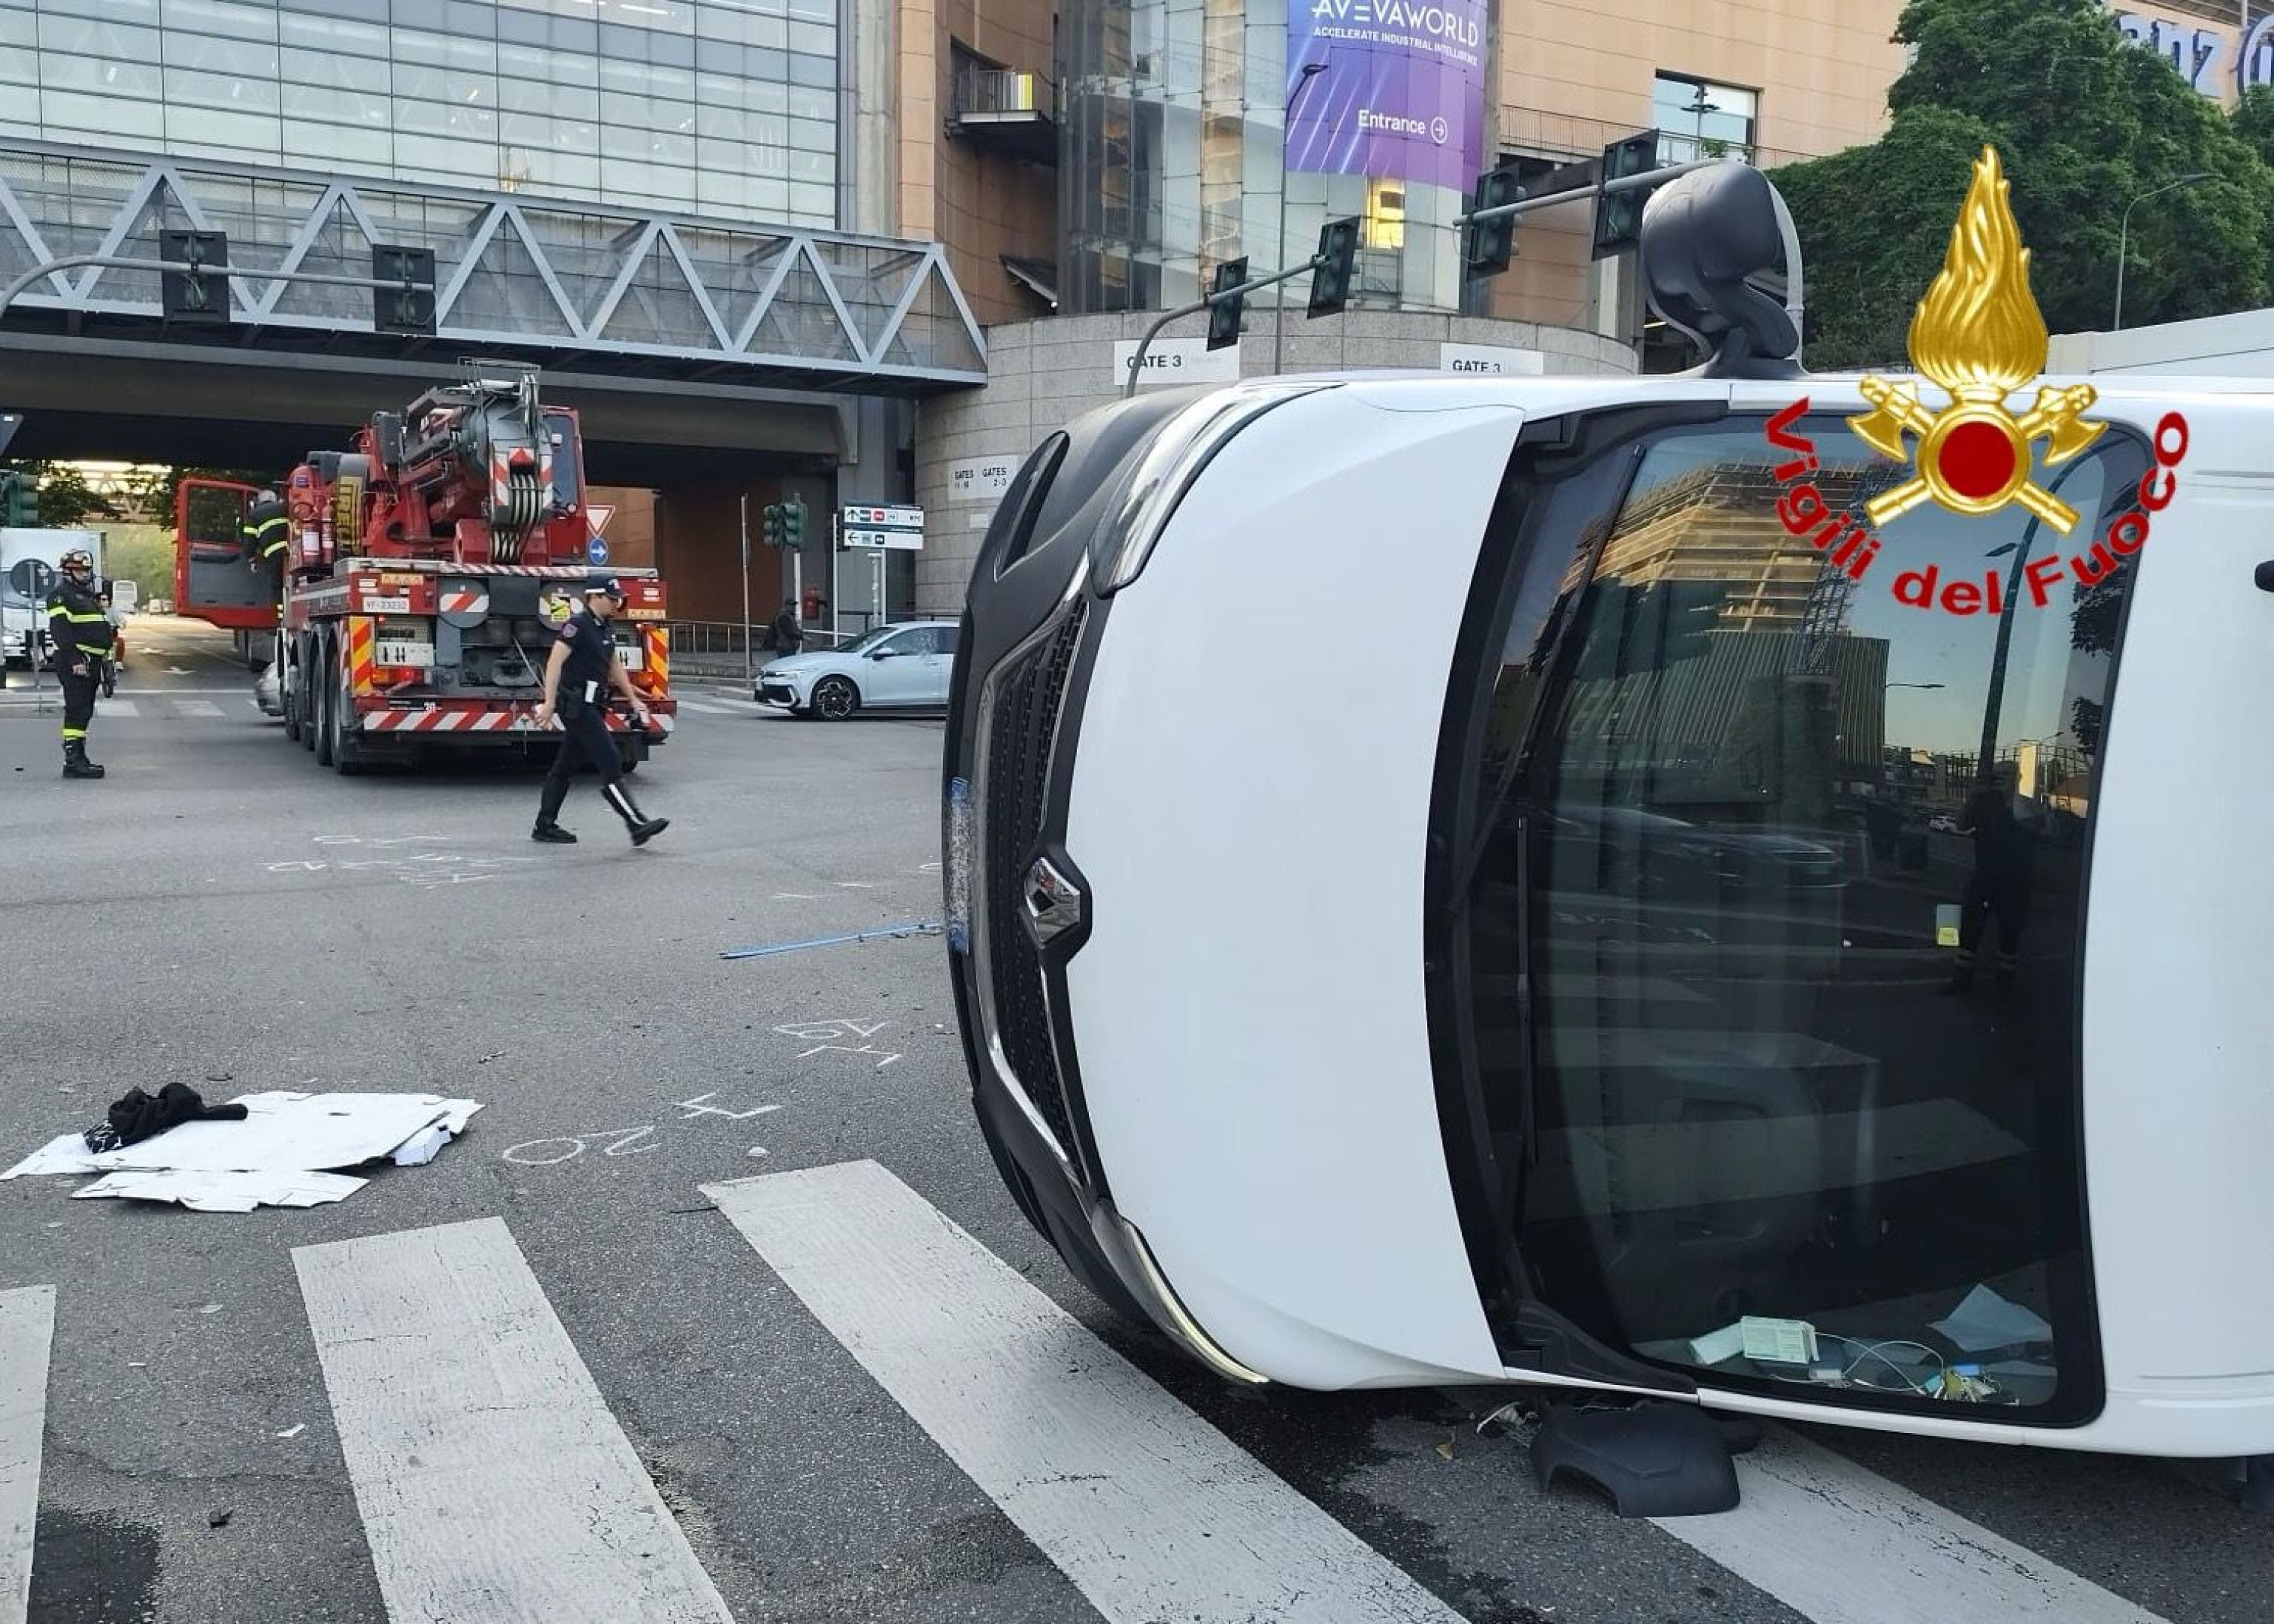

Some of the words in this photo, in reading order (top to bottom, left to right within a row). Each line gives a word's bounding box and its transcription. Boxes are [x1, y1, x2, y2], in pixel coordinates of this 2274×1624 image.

[1314, 26, 1380, 41] ACCELERATE
[1381, 33, 1433, 50] INDUSTRIAL
[1358, 109, 1426, 135] Entrance
[1173, 355, 1182, 368] 3
